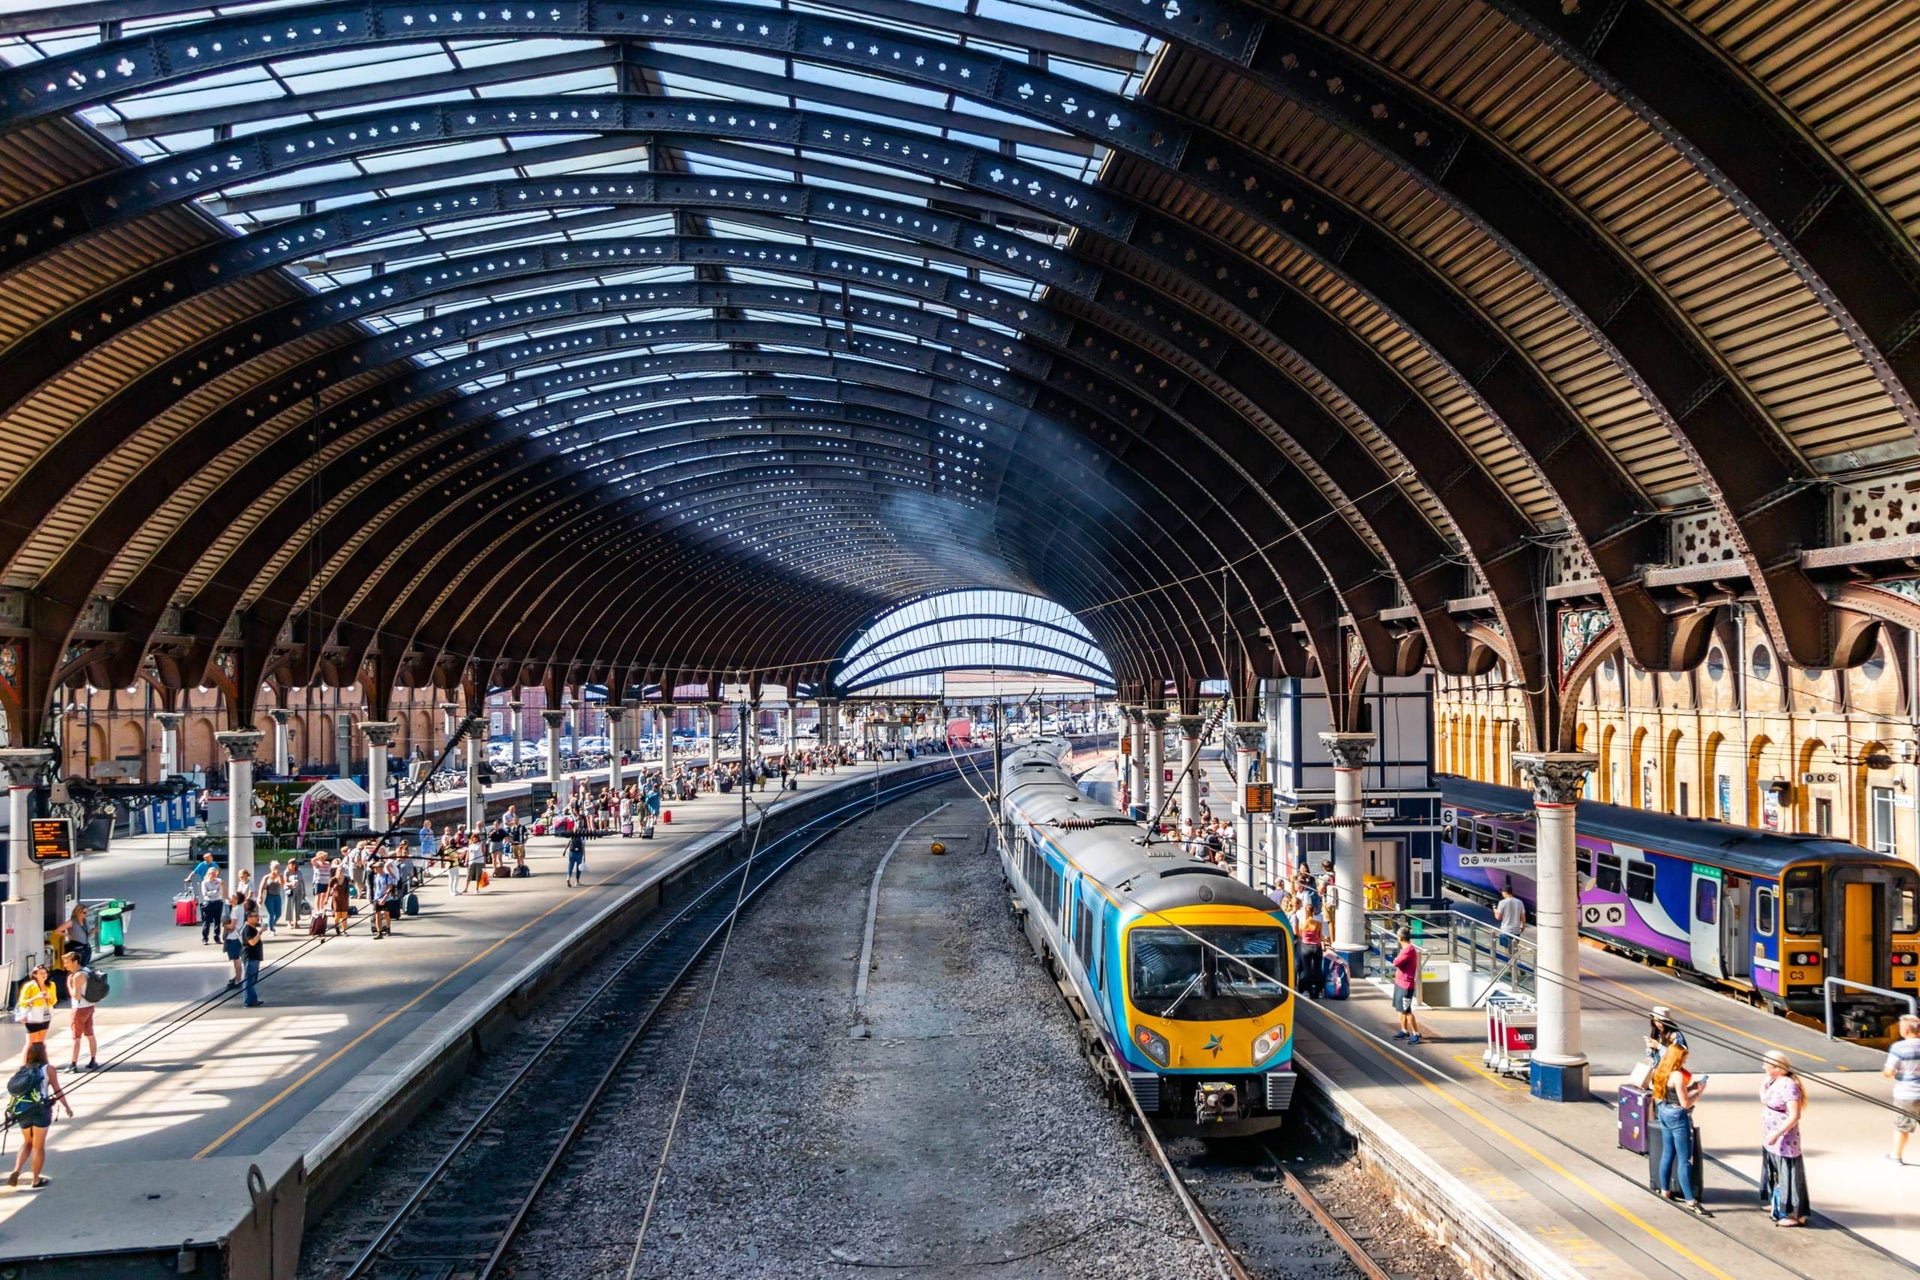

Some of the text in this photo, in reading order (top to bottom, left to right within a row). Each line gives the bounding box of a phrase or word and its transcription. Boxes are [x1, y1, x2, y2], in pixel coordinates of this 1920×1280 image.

[1443, 810, 1453, 823] 6
[1789, 970, 1805, 981] C3
[1514, 1033, 1535, 1041] LNER
